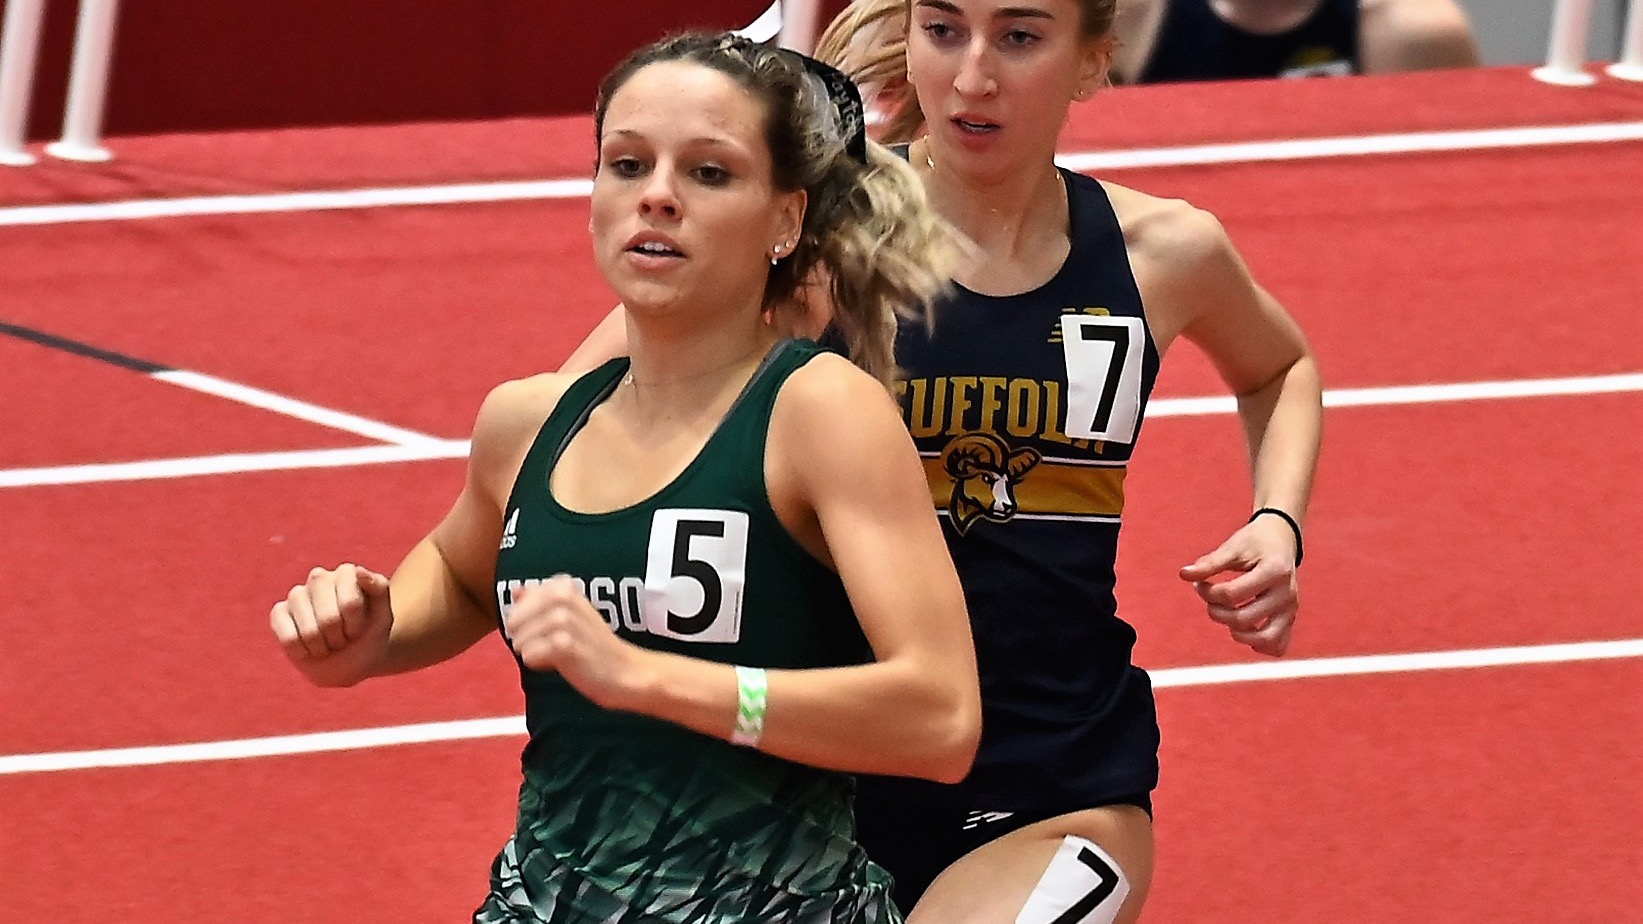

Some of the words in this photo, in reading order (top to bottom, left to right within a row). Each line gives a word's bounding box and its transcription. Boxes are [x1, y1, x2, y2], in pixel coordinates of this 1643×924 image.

[897, 376, 1105, 454] UFFOL
[1080, 323, 1130, 433] 7
[666, 518, 725, 636] 5
[1050, 845, 1120, 924] 7
